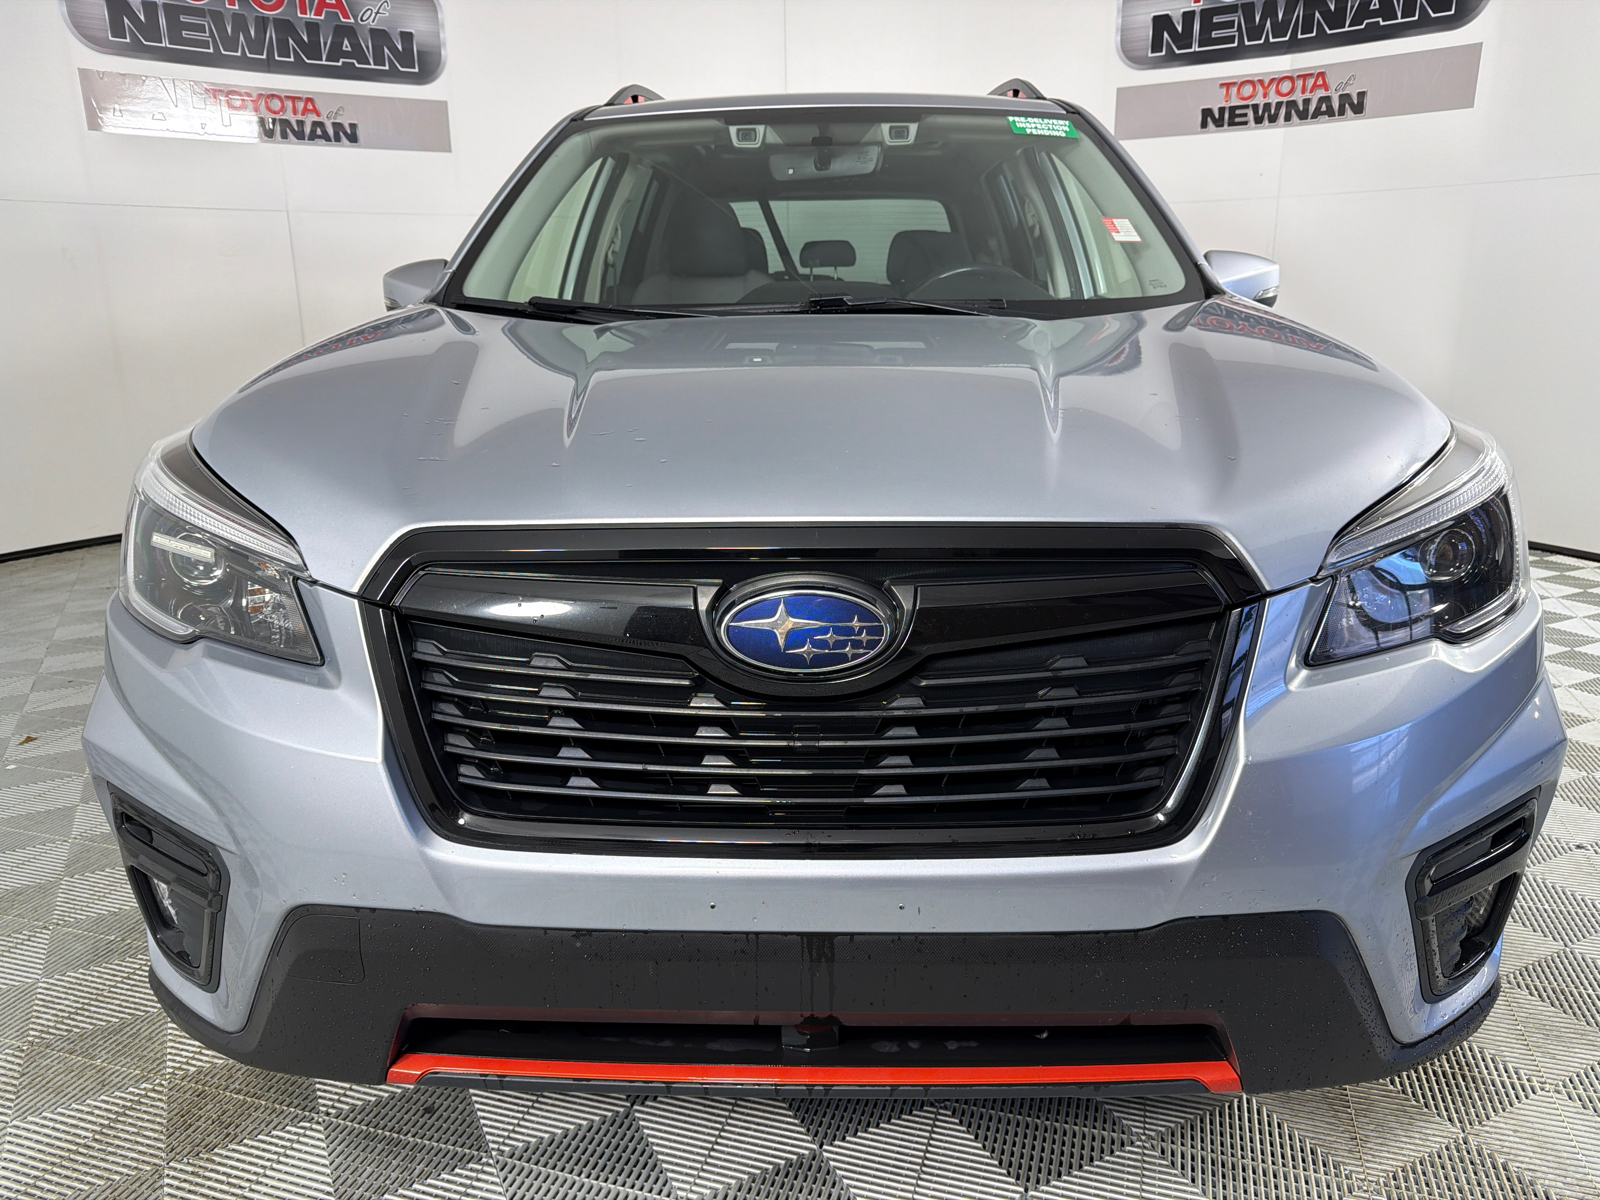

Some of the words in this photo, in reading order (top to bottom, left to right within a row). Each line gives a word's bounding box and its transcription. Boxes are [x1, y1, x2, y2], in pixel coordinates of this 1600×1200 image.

[358, 0, 391, 25] of
[108, 0, 418, 71] NEWNAN
[1219, 70, 1330, 104] TOYOTA
[1334, 73, 1356, 93] of
[206, 87, 322, 118] TOYOTA
[326, 106, 345, 121] of
[1200, 90, 1367, 131] NEWNAN
[258, 116, 359, 144] WNAN
[1008, 116, 1069, 126] PRE-DELIVERY
[1015, 122, 1070, 132] INSPECTION
[1025, 128, 1066, 137] PENDING
